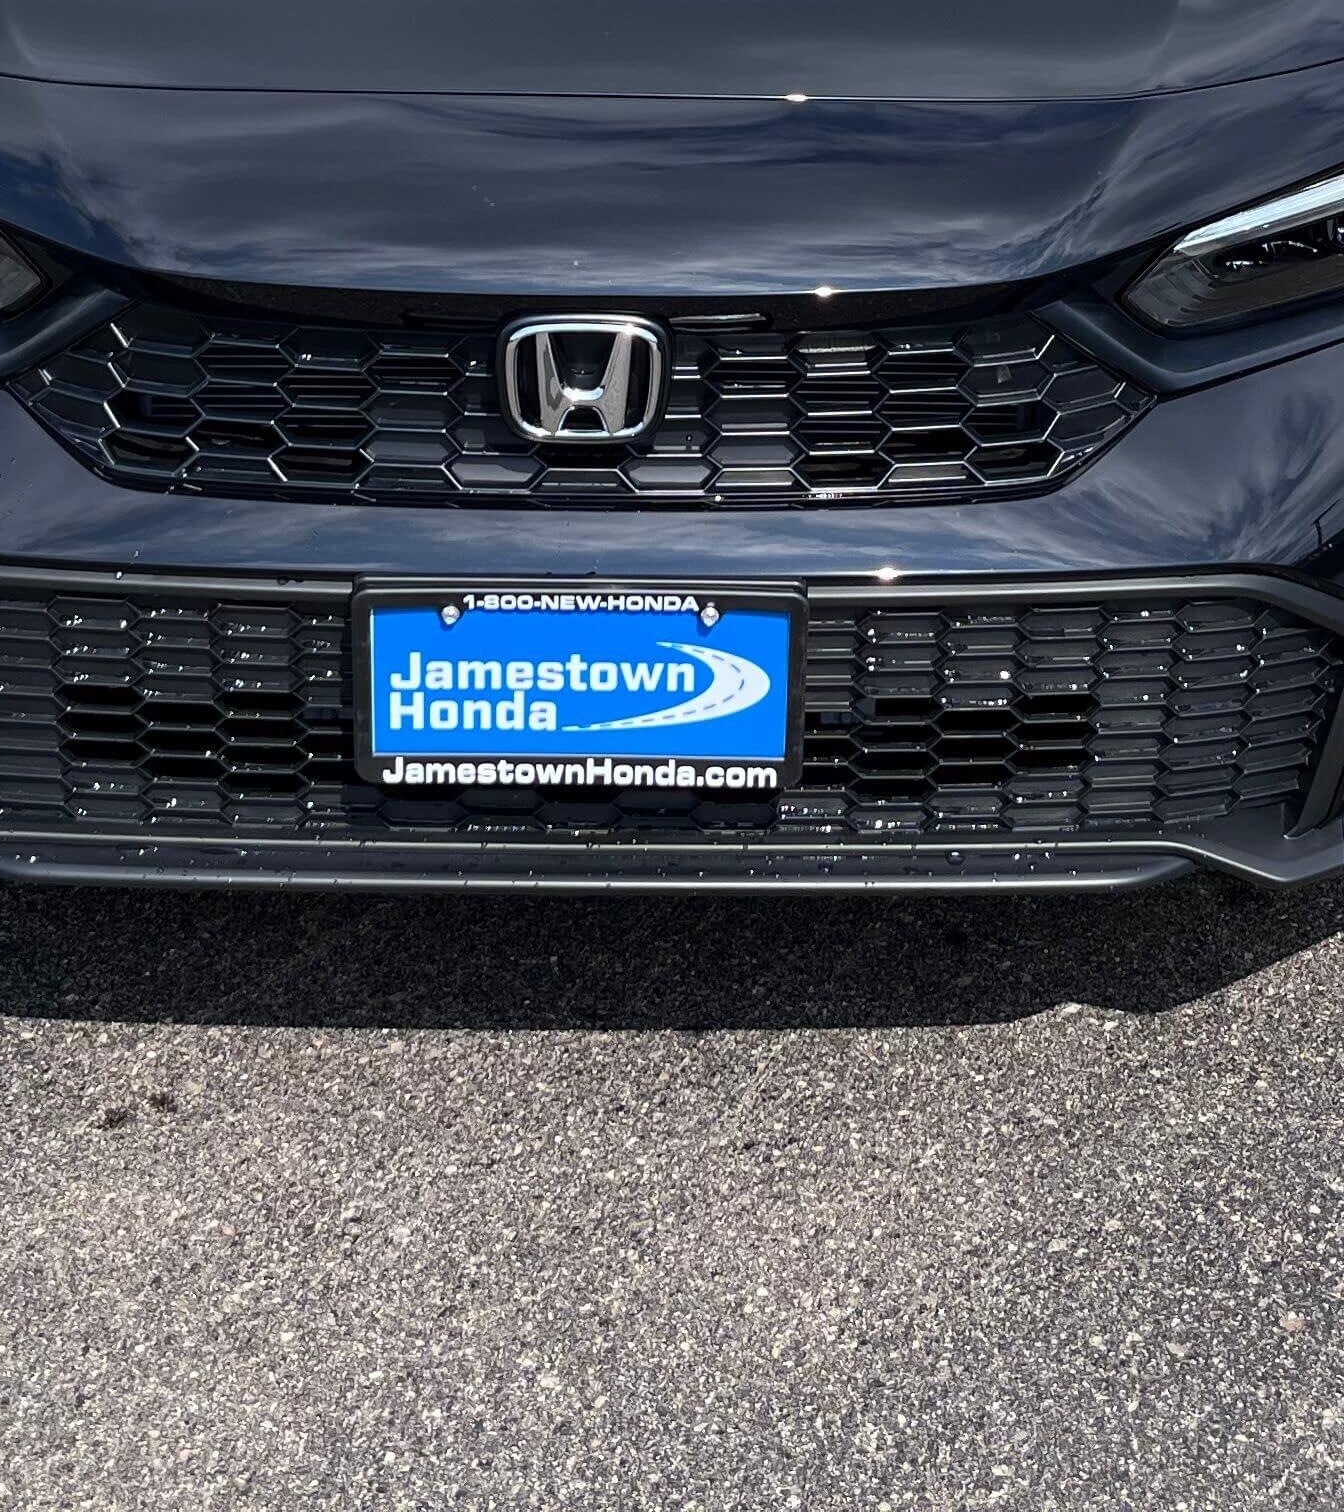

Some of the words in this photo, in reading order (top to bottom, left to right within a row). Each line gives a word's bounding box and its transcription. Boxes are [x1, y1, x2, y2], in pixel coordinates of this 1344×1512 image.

[463, 594, 700, 613] 1-800-NEW-HONDA
[390, 651, 695, 692] Jamestown
[390, 691, 557, 732] Honda
[382, 756, 778, 788] JamestownHonda.com
